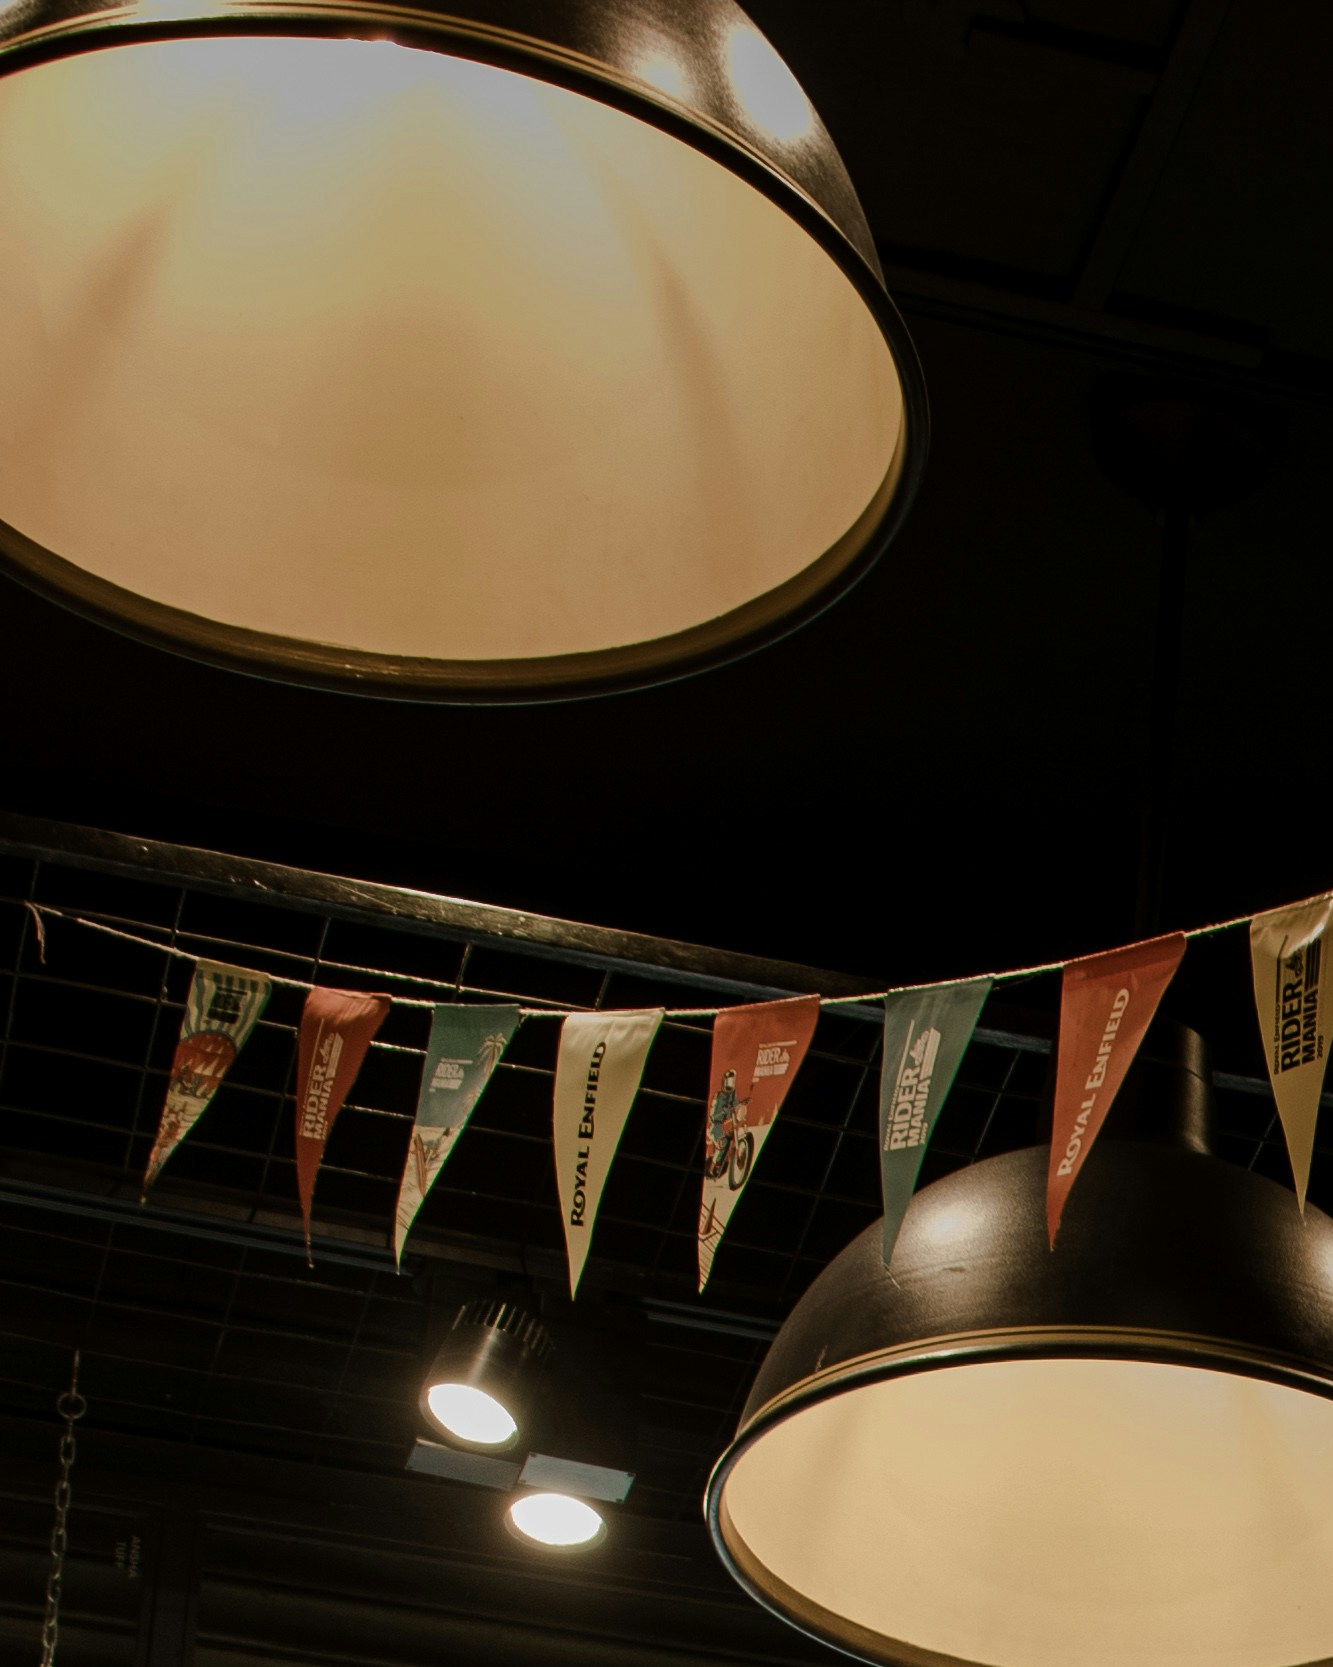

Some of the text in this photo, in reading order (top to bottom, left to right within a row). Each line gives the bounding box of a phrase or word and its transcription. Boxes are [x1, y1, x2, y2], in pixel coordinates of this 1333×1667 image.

[1281, 979, 1302, 1073] RIDER
[1302, 988, 1318, 1064] MANIA
[303, 1065, 327, 1138] RIDER
[313, 1076, 334, 1140] MANIA
[890, 1066, 920, 1151] RIDER
[907, 1079, 931, 1147] MANIA
[1057, 988, 1130, 1177] ROYAL ENFIELD
[571, 1041, 607, 1227] ROYAL ENFIELD
